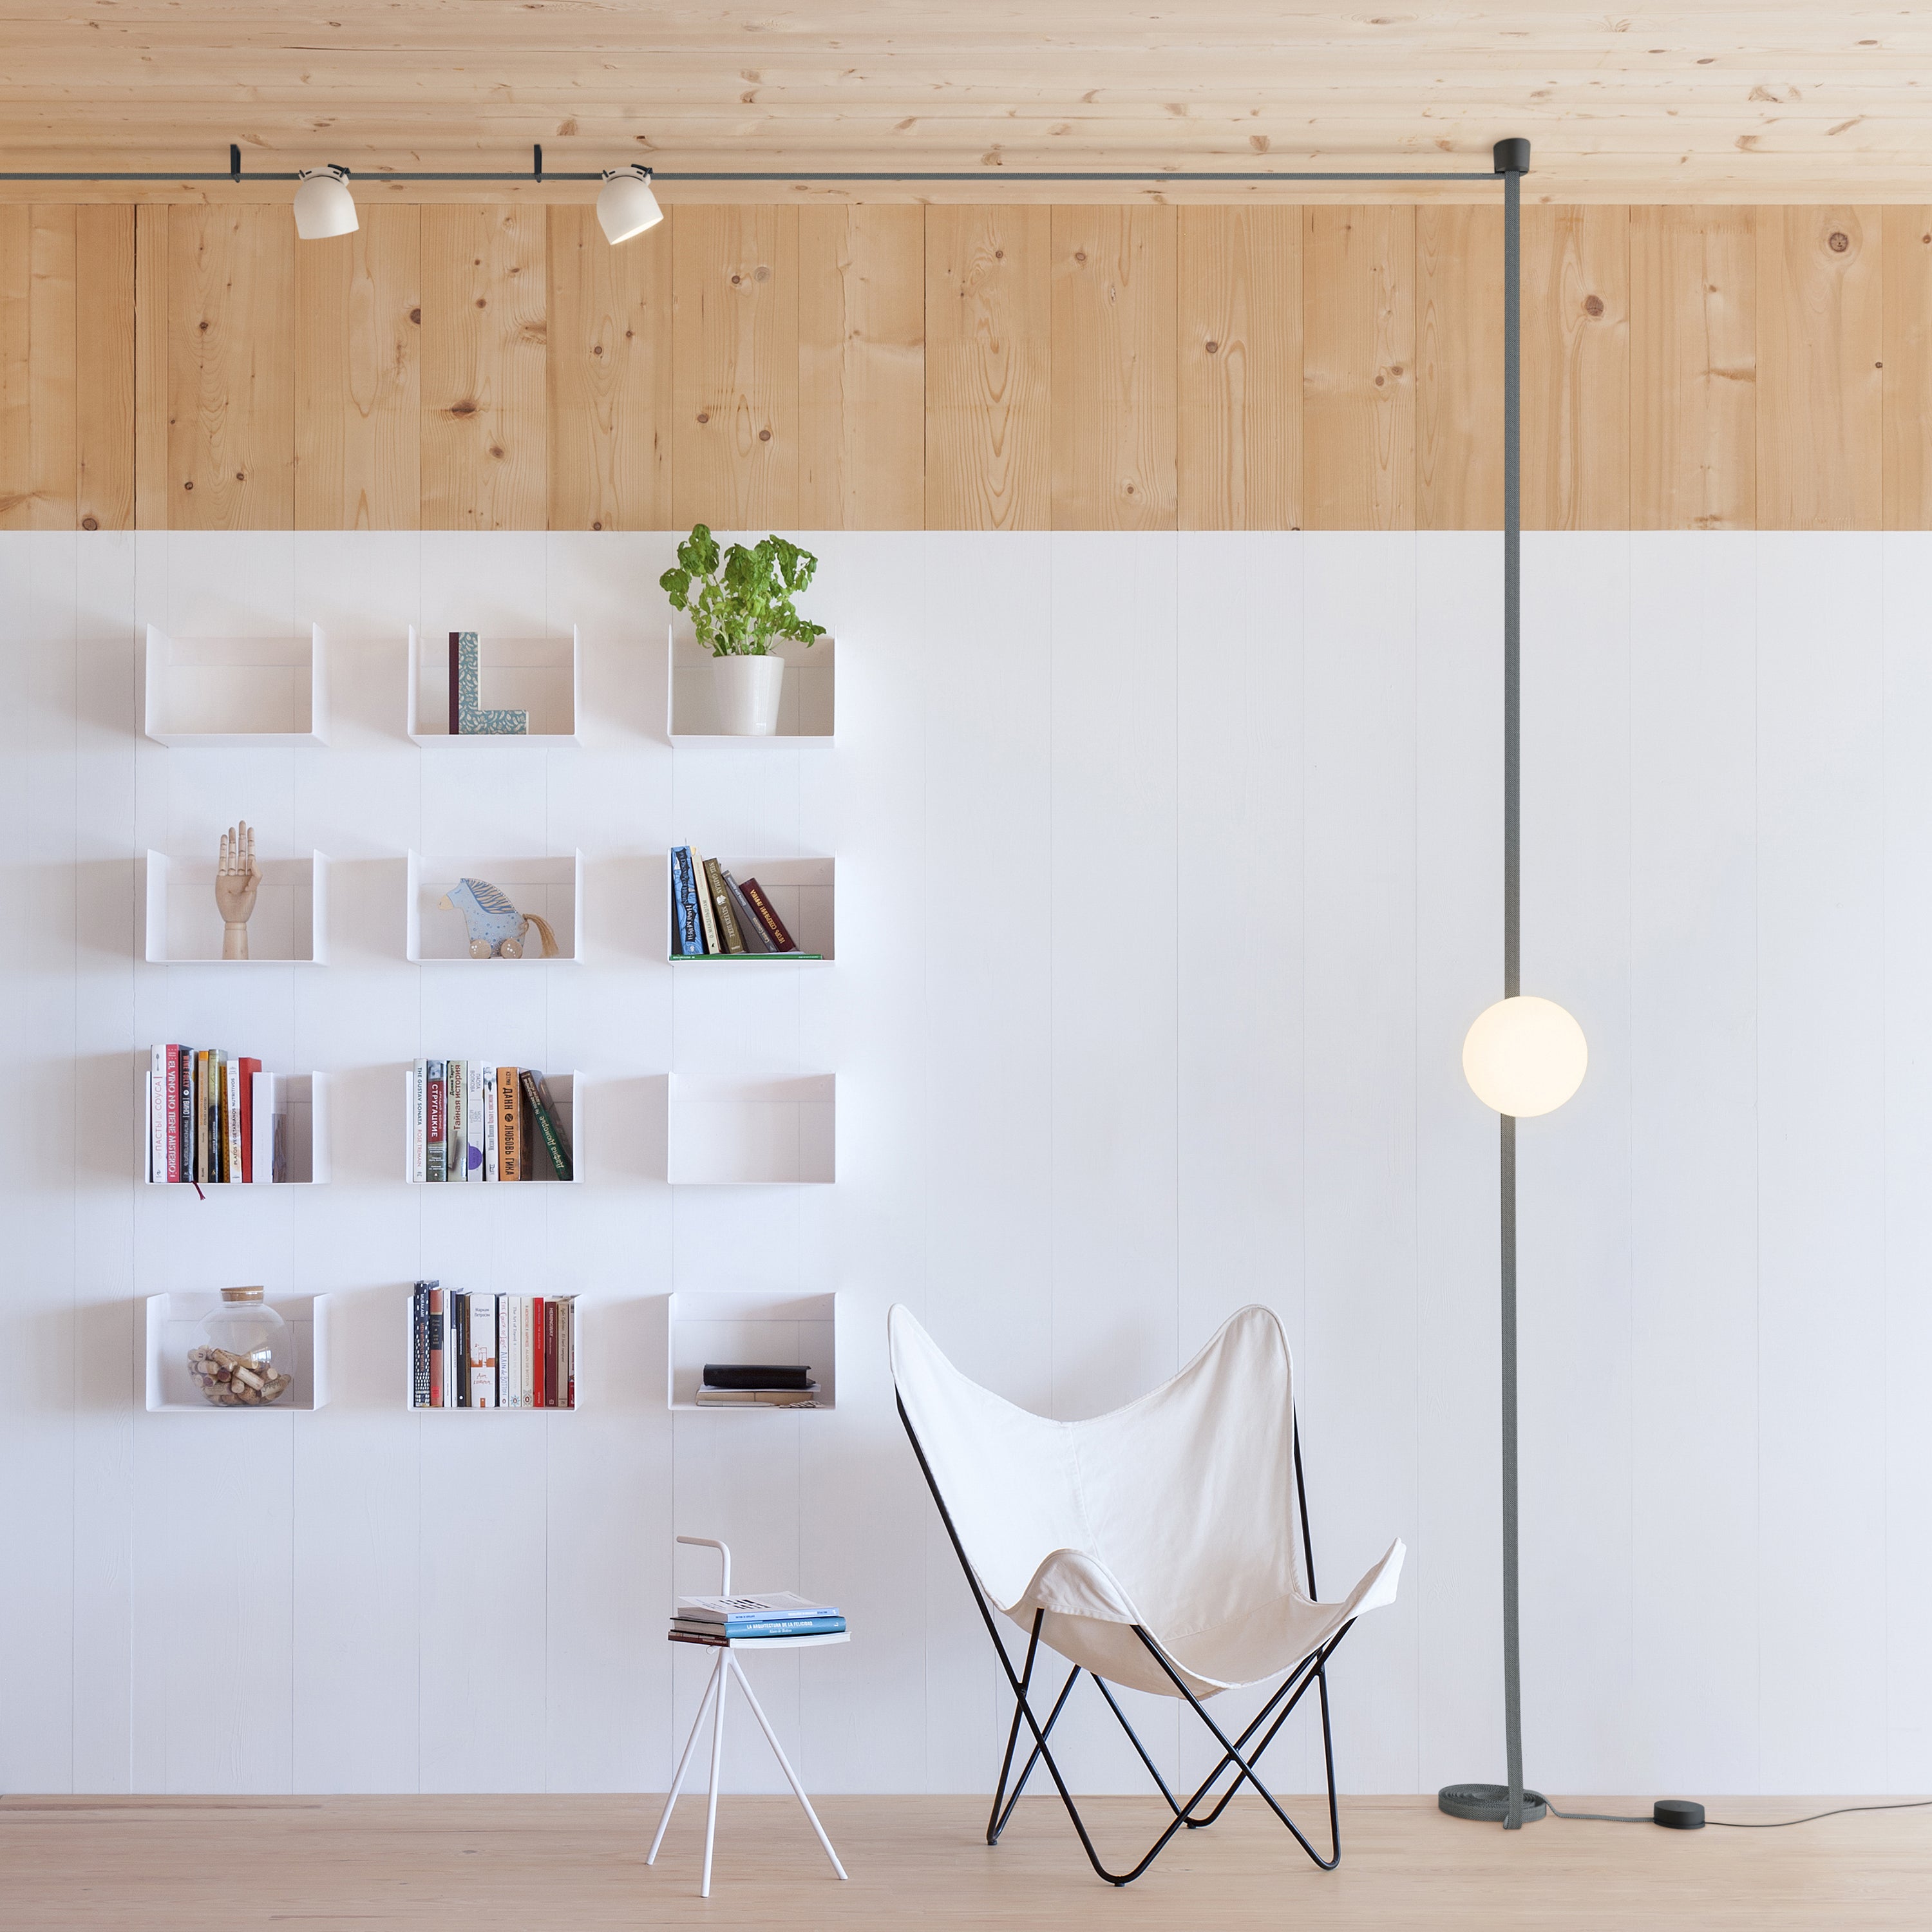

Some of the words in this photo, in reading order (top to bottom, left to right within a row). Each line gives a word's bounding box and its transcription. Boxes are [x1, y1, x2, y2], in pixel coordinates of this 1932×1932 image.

[708, 862, 717, 874] NEIL
[711, 874, 722, 895] GAIMAN
[685, 905, 694, 921] HARRY
[703, 900, 713, 933] МАНДЕЛЬШТАМ
[721, 906, 735, 937] NEVERWHERE
[685, 920, 696, 940] MULISCH
[752, 917, 764, 934] Соколов
[761, 932, 770, 943] Саша
[773, 929, 785, 943] ИГОРЬ
[168, 1061, 175, 1070] EL
[168, 1095, 175, 1109] NO
[503, 1088, 513, 1110] ДАНН
[505, 1125, 514, 1154] ЛЮБОВЬ
[539, 1116, 556, 1146] Дюморье
[551, 1146, 564, 1168] Дафна
[505, 1158, 514, 1175] ГИКА
